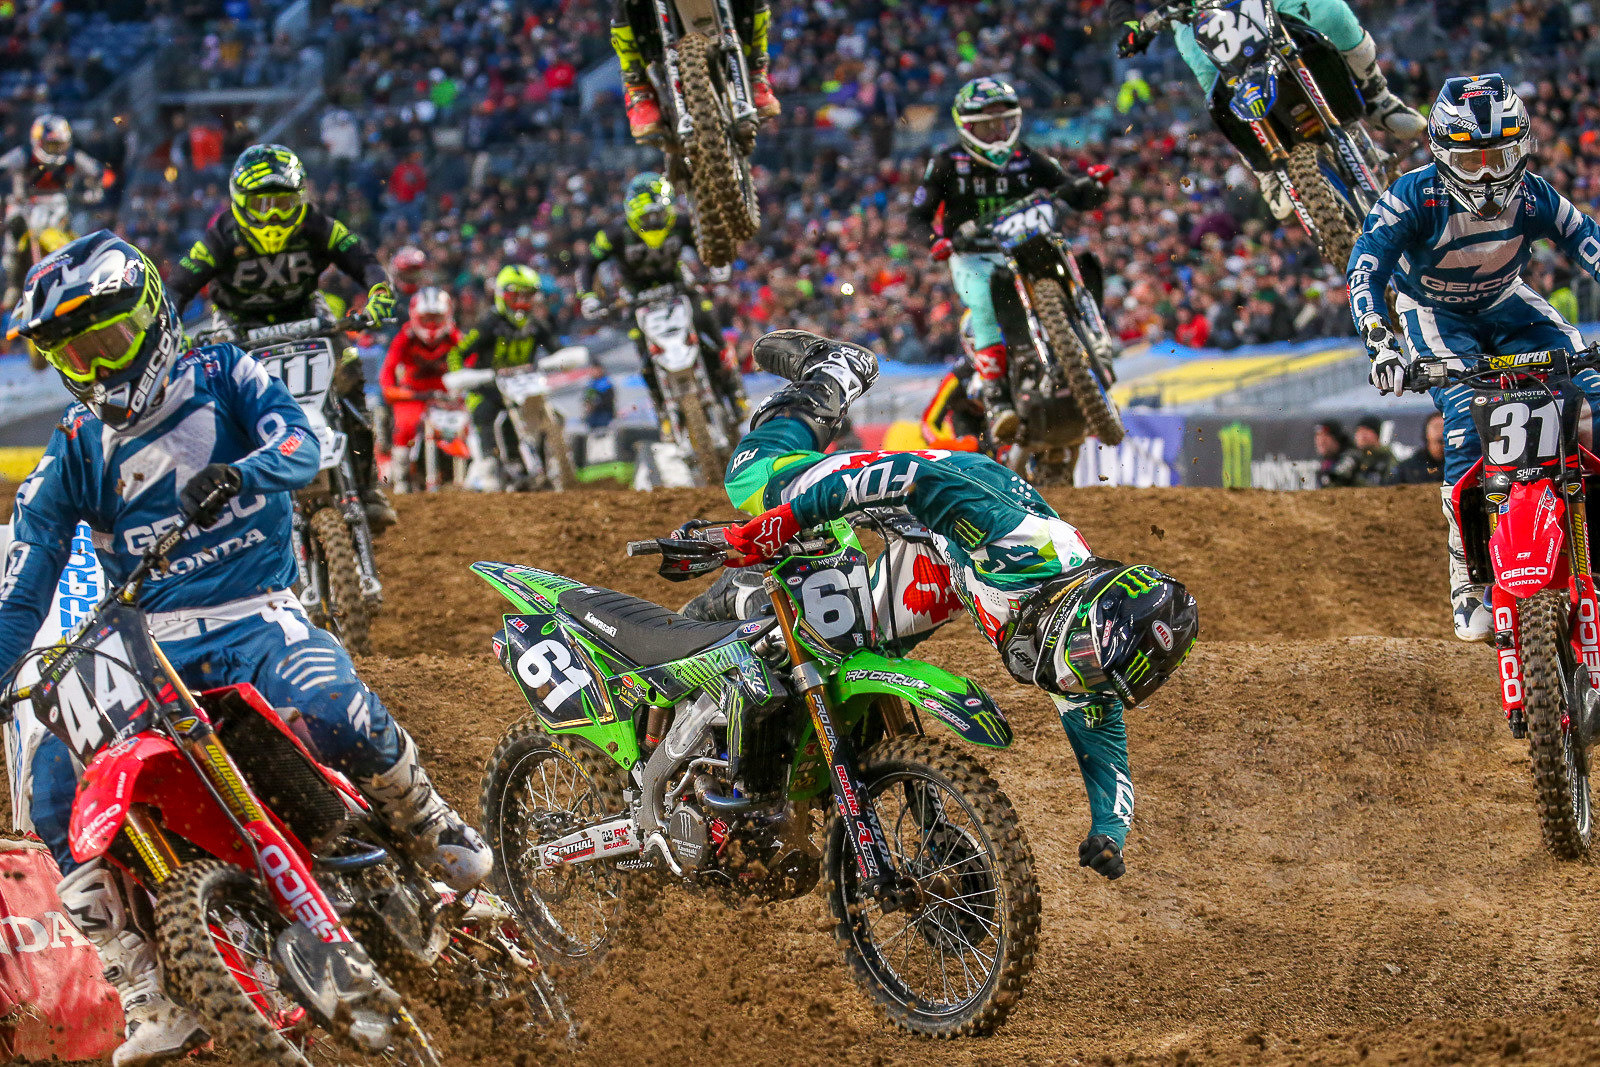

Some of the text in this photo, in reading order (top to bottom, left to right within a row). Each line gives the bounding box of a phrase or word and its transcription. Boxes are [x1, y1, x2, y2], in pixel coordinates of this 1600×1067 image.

[1207, 0, 1269, 63] 34
[1276, 170, 1315, 228] DULOP
[1350, 253, 1379, 318] GEIC
[131, 330, 173, 414] GEICO
[730, 447, 759, 473] FOX
[1488, 399, 1565, 465] 31
[839, 460, 920, 512] FOX
[1516, 467, 1543, 480] SHIFT
[58, 523, 99, 638] ERCROSS
[150, 528, 268, 582] HONDA
[1501, 566, 1548, 580] GEICO
[802, 565, 873, 641] 61
[1508, 579, 1542, 588] HONDA
[584, 611, 618, 638] Kawasaki
[1156, 624, 1171, 647] BELL
[516, 639, 593, 714] 61
[868, 670, 932, 690] CIRCUIT
[1495, 606, 1522, 704] GICO
[56, 630, 145, 755] 44
[835, 764, 860, 817] BRAKING
[614, 827, 629, 839] RK
[260, 844, 343, 943] GEICO
